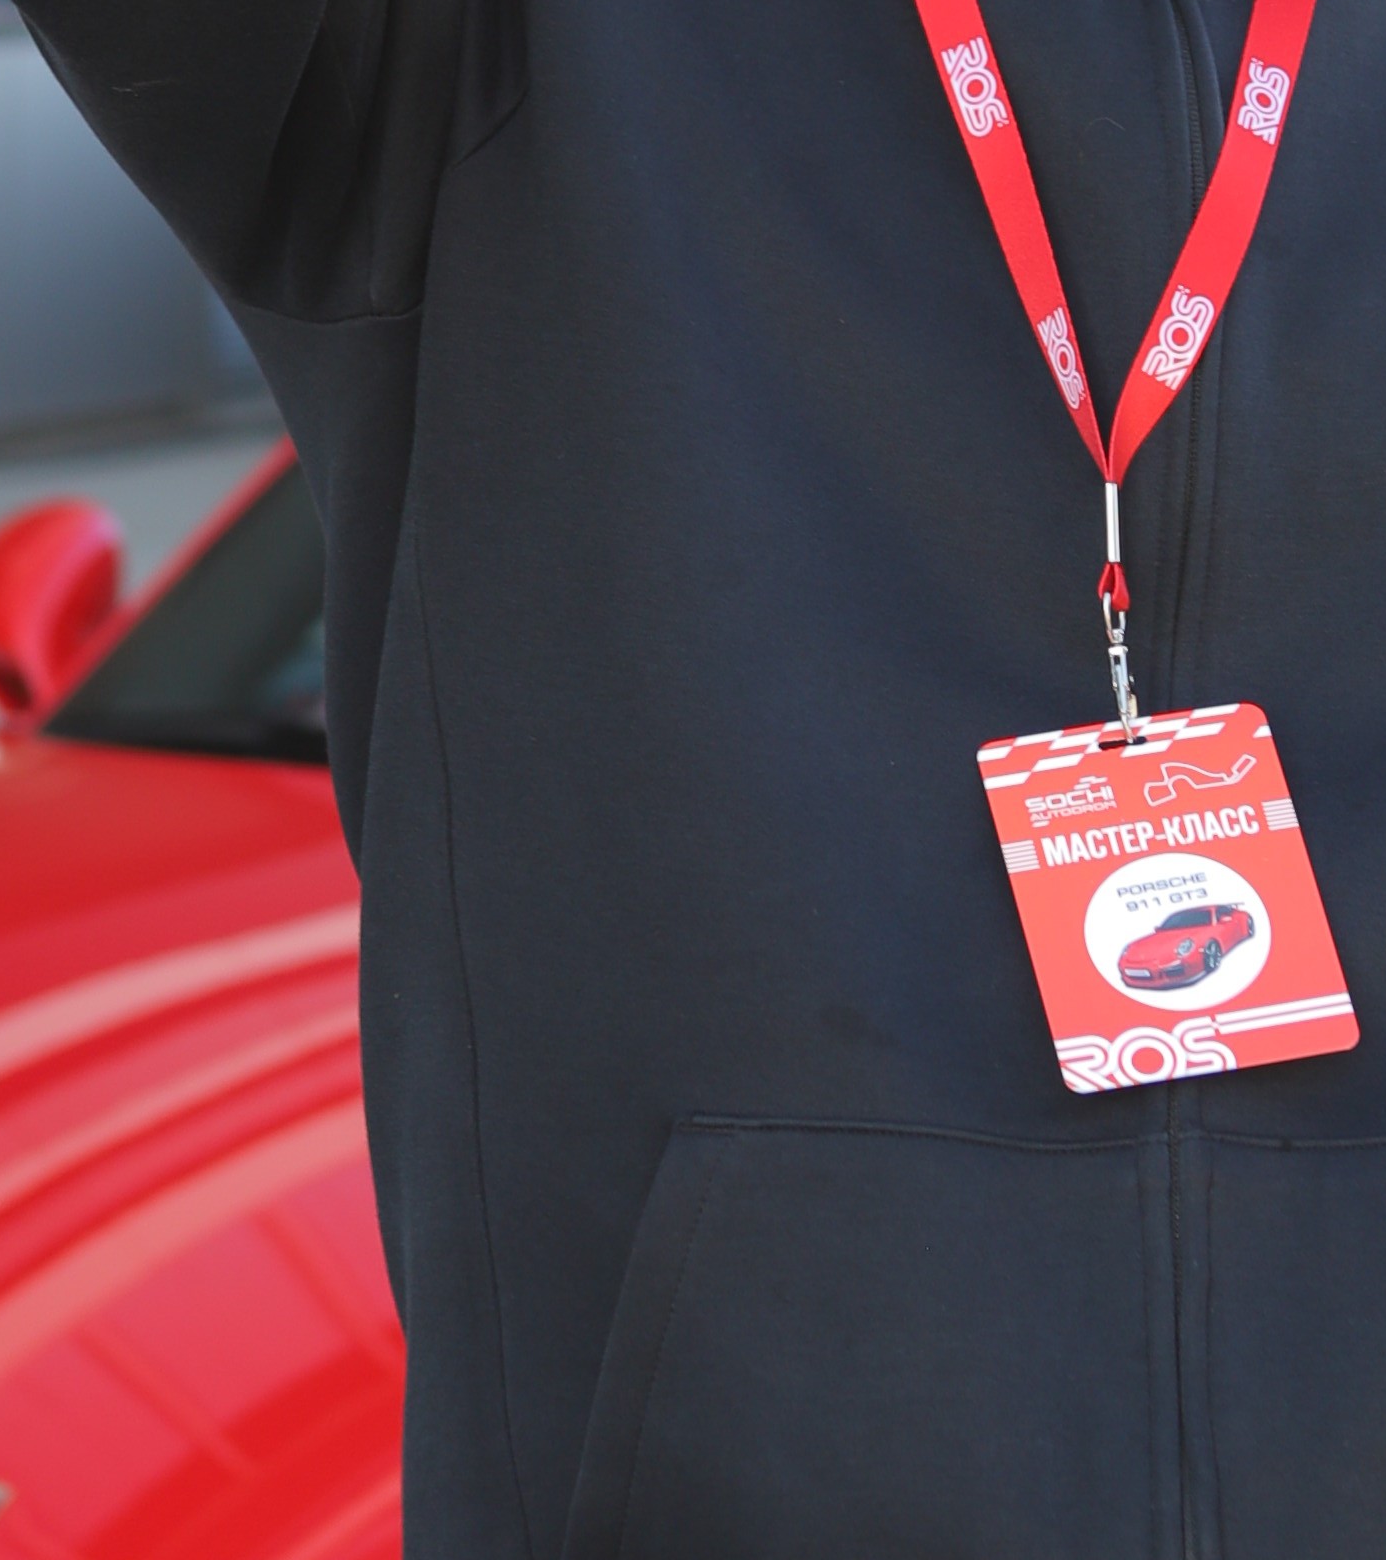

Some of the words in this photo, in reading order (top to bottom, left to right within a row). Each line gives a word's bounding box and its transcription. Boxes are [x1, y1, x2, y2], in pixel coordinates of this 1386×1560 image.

[941, 37, 1010, 138] ROS
[1238, 57, 1290, 144] ROS
[1037, 307, 1087, 410] ROS
[1141, 285, 1215, 390] ROS
[1025, 785, 1115, 813] SOCHI
[1041, 804, 1260, 868] МАСТЕР-КЛАСС
[1116, 872, 1208, 898] PORSCHE
[1125, 896, 1162, 913] 911
[1169, 888, 1208, 904] GT3
[1054, 1016, 1238, 1094] ROS
